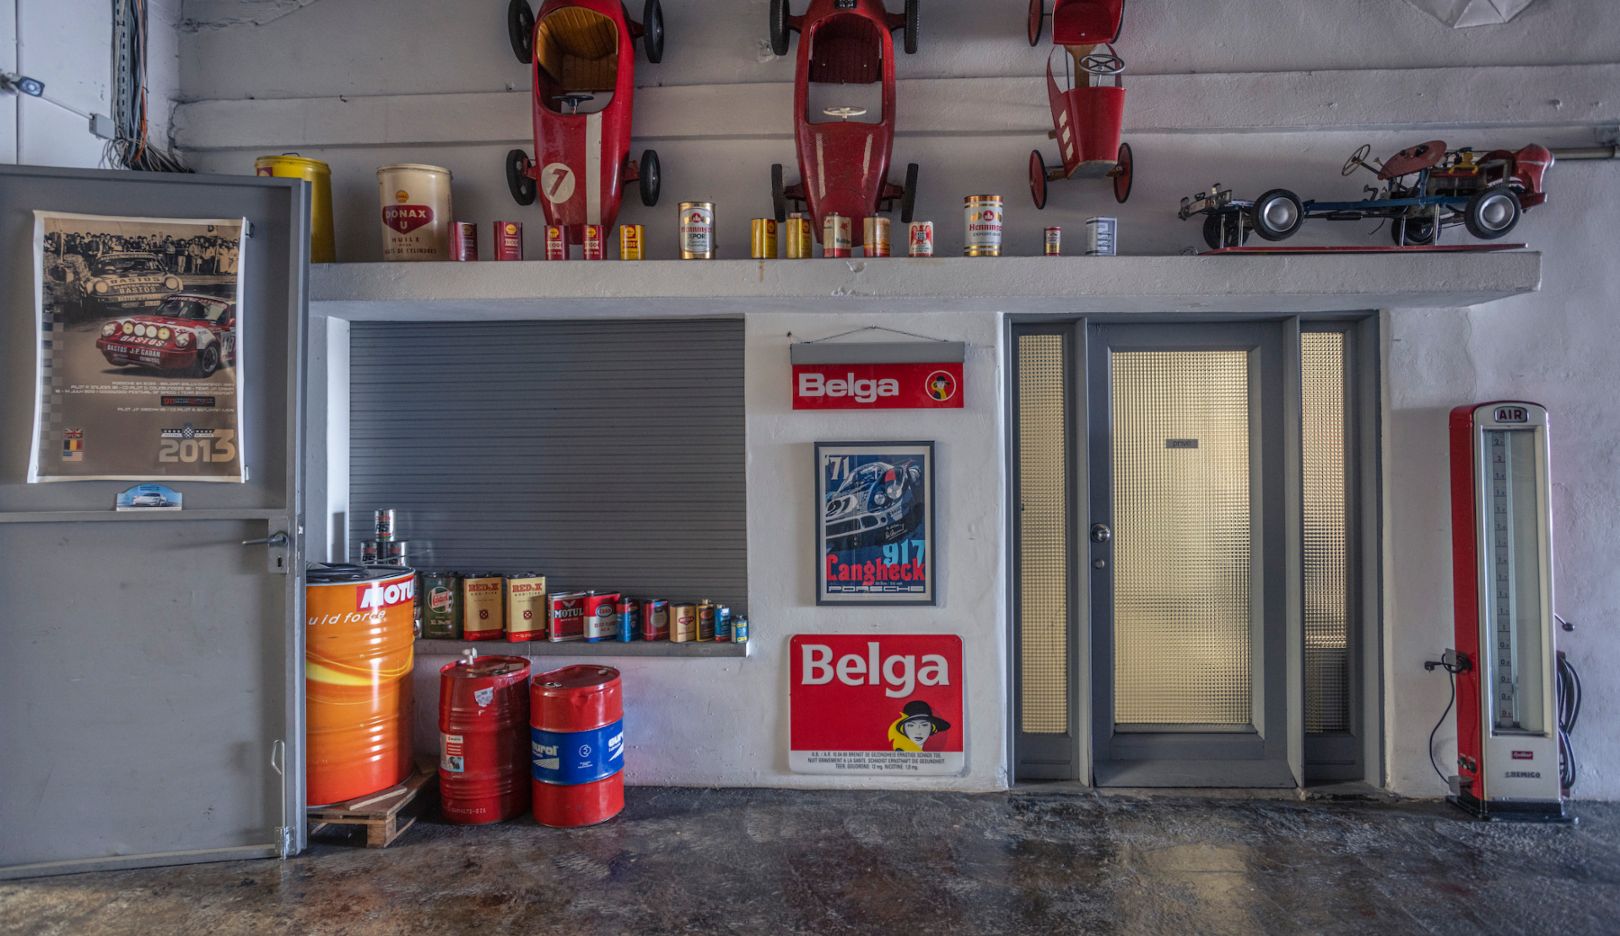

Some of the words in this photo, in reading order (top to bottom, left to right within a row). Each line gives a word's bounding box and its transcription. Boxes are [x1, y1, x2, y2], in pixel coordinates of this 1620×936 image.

[549, 168, 569, 197] 7
[385, 209, 427, 219] DONAX
[120, 335, 165, 347] BASTOS
[798, 372, 900, 404] Belga
[1499, 409, 1523, 420] AIR
[158, 428, 236, 463] 2013
[883, 540, 926, 568] 917
[360, 578, 414, 609] MOTU
[827, 585, 924, 593] PORSCHE
[554, 608, 584, 619] MOTUL
[801, 642, 950, 699] Belga
[608, 731, 624, 749] eur
